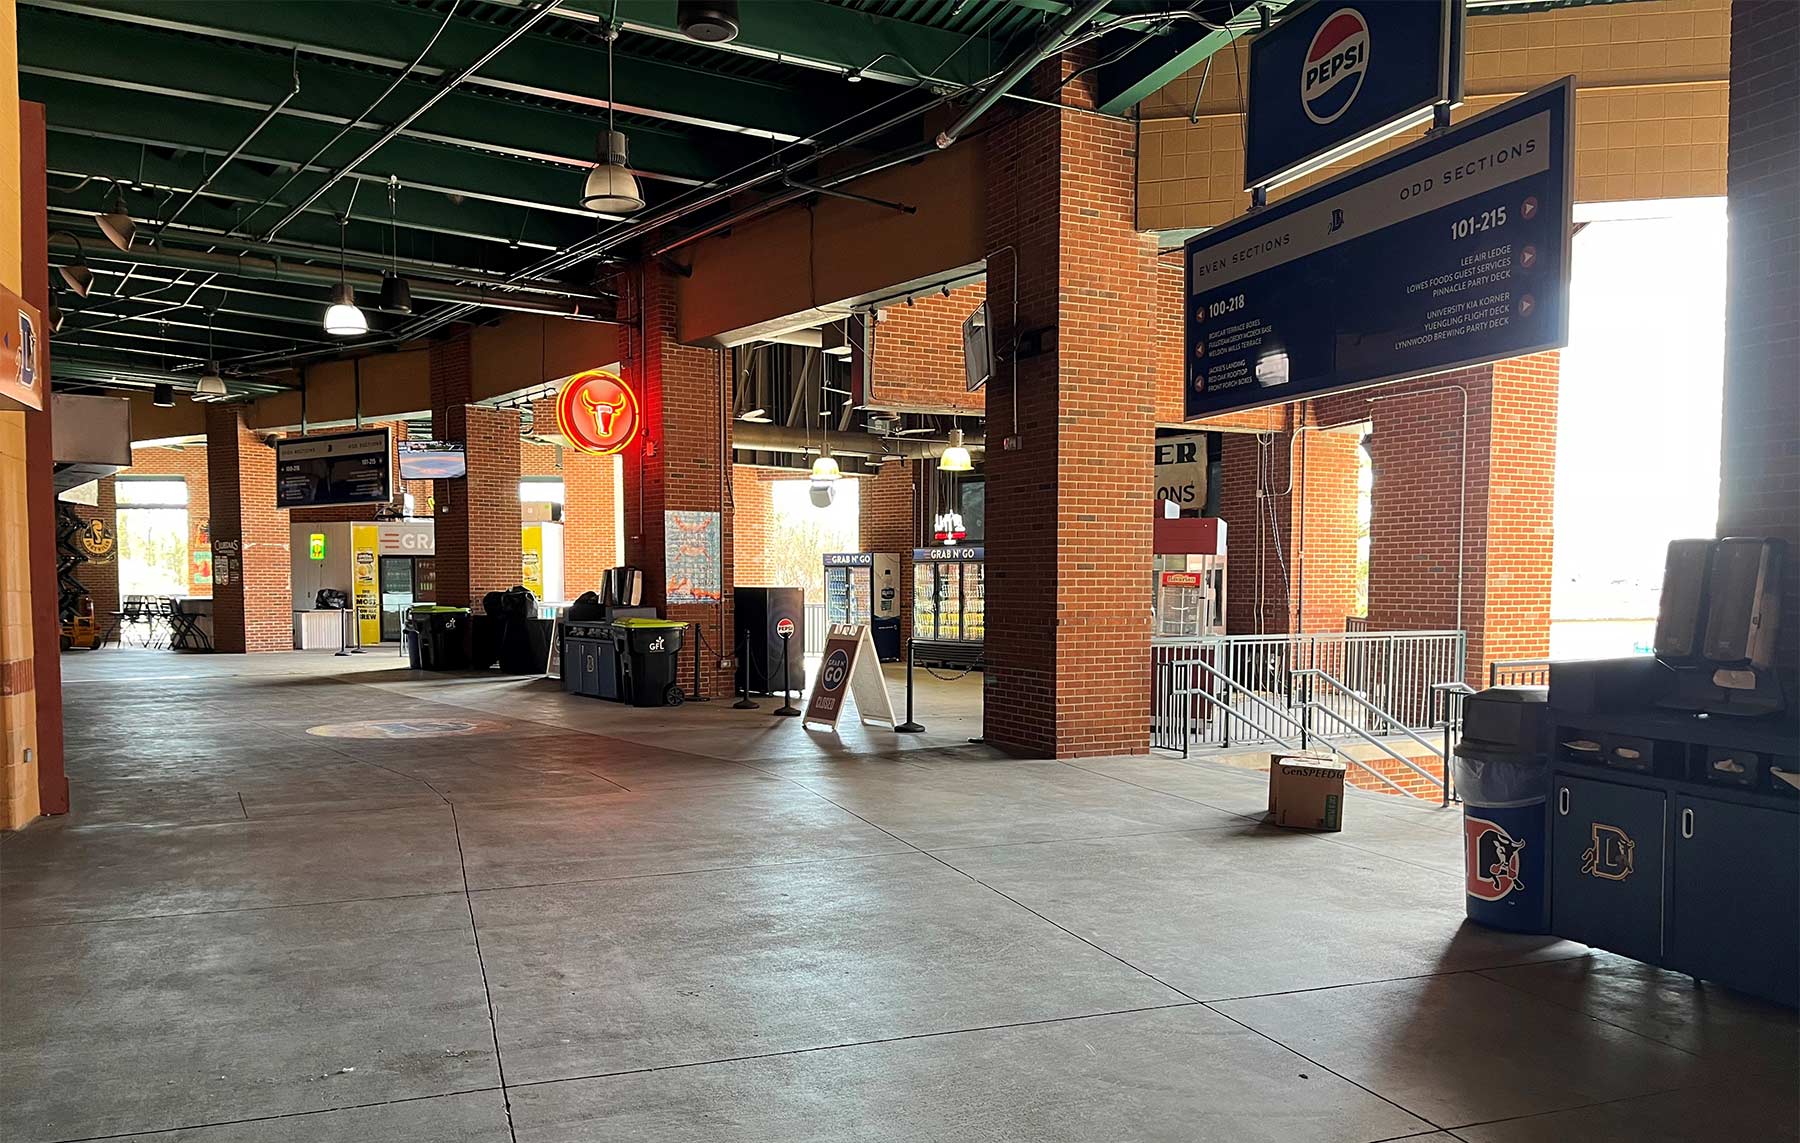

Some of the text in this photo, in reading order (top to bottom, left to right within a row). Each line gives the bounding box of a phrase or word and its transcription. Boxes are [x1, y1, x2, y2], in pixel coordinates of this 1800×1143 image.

[1306, 40, 1364, 92] PEPSI
[1400, 138, 1537, 201] ODD SECTIONS
[1451, 206, 1507, 240] 101-215
[1199, 233, 1291, 277] EVEN SECTIONS
[1461, 244, 1511, 266] LEE AIR LEDGE
[1406, 256, 1511, 294] LOWES FOODS GUEST SERVICES
[1432, 269, 1511, 298] PINNACLE PARTY DECK
[1208, 294, 1245, 318] 100-218
[1424, 304, 1510, 332] YUENGLING FLIGHT DECK
[1426, 291, 1510, 320] UNIVERSITY KIA KORNER
[1394, 317, 1509, 350] LYNNWOOD BREWING PARTY DECK
[1157, 484, 1195, 502] ONS
[831, 555, 850, 563] GRAB
[859, 555, 870, 563] GO
[930, 549, 951, 559] GRAB
[962, 548, 974, 559] GO
[649, 637, 665, 650] GFL
[825, 667, 842, 682] GO
[815, 695, 836, 710] CLOSED
